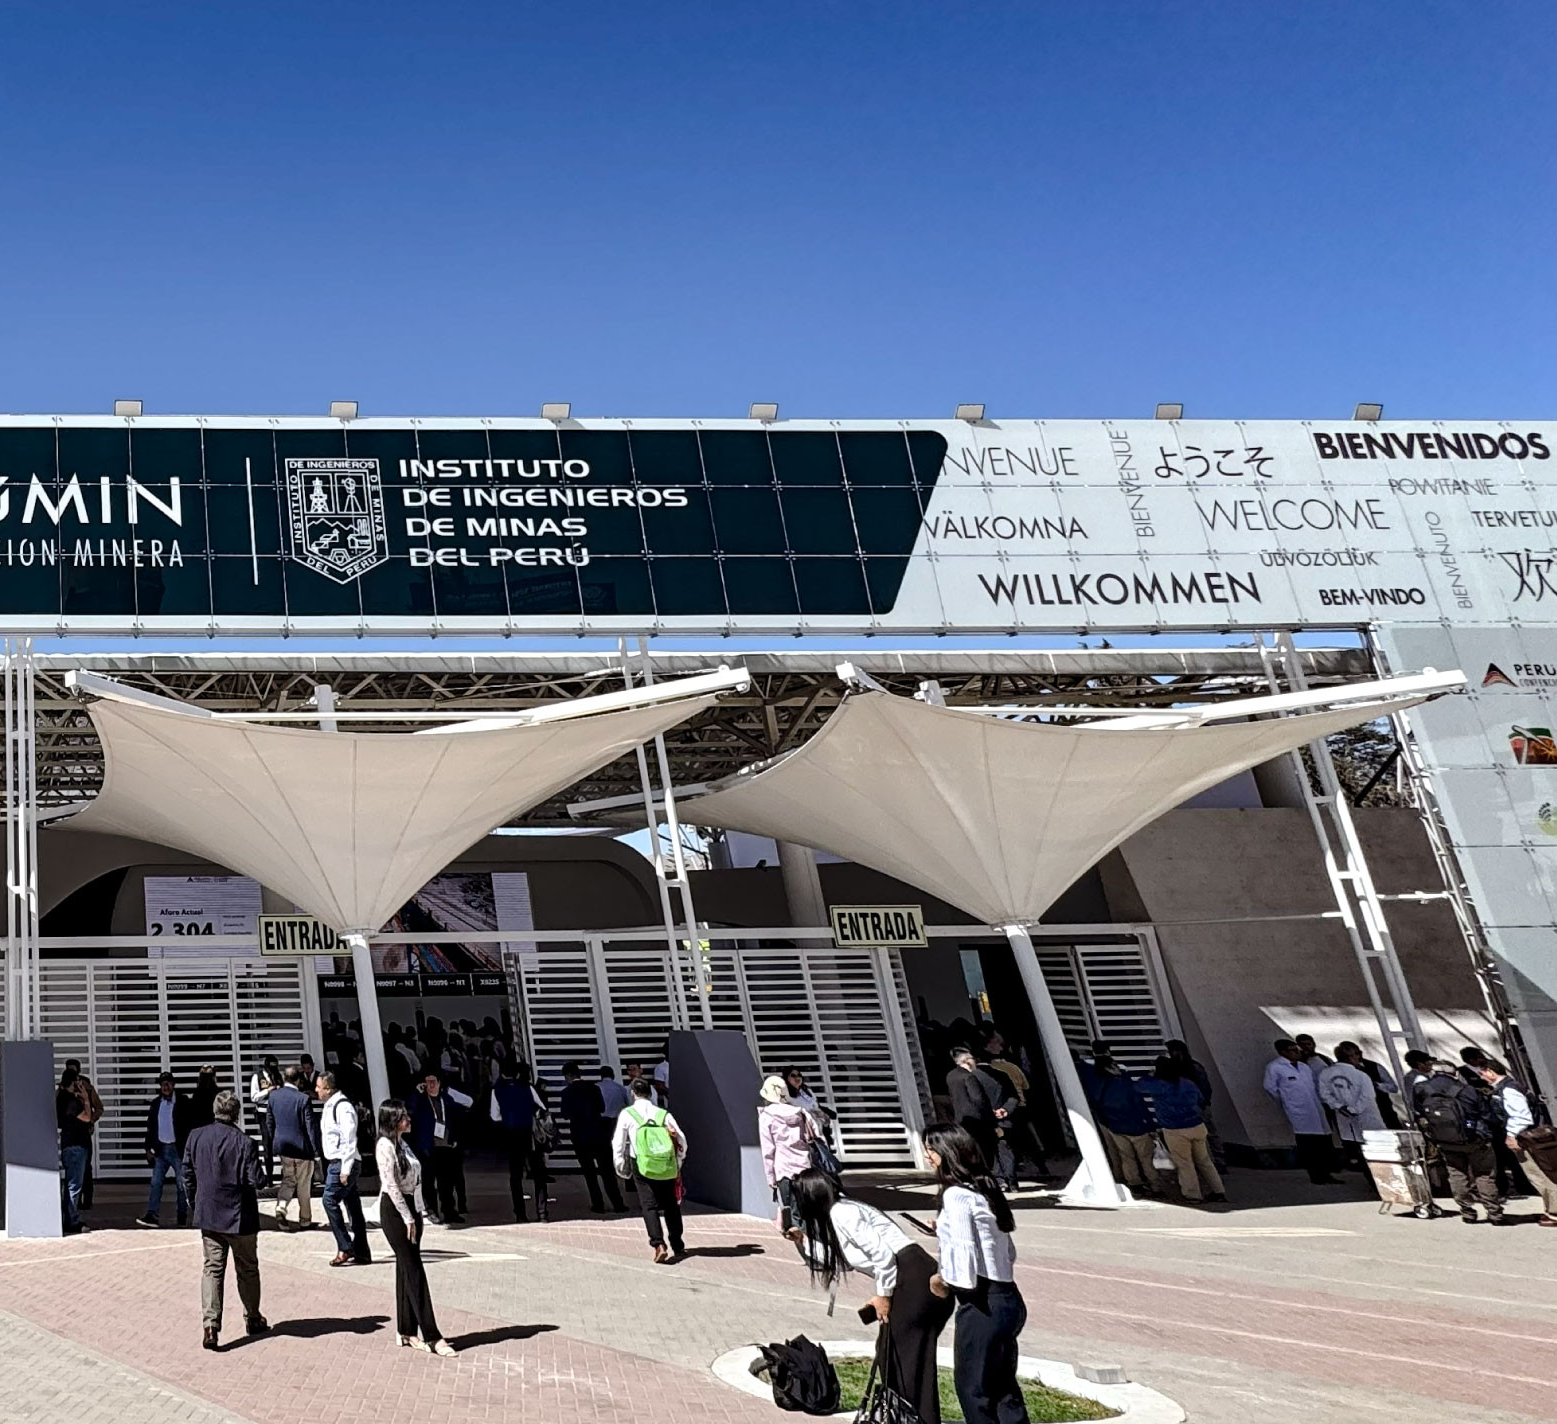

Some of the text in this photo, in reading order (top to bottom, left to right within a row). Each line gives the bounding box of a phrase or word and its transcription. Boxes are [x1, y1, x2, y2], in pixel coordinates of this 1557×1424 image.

[1312, 432, 1551, 460] BIENVENIDOS
[289, 461, 376, 469] DE INGENIEROS
[399, 459, 590, 478] INSTITUTO
[1154, 446, 1274, 479] ようこそ
[402, 488, 689, 507] DE INGENIEROS
[1109, 429, 1155, 537] BIENVENUE
[1388, 478, 1499, 495] POWITANIE
[289, 475, 303, 543] INSTITUTO
[369, 475, 385, 541] DE MINAS
[1193, 499, 1390, 531] WELCOME
[406, 517, 587, 537] DE MINAS
[923, 510, 1089, 539] VÄLKOMNA
[74, 538, 185, 568] MINERA
[306, 557, 330, 574] DEL
[409, 543, 591, 567] DEL PERÚ
[1425, 511, 1473, 609] BIENVENUTO
[978, 571, 1263, 606] WILLKOMMEN
[1318, 588, 1426, 606] BEM-VINDO
[836, 912, 921, 941] ENTRADA
